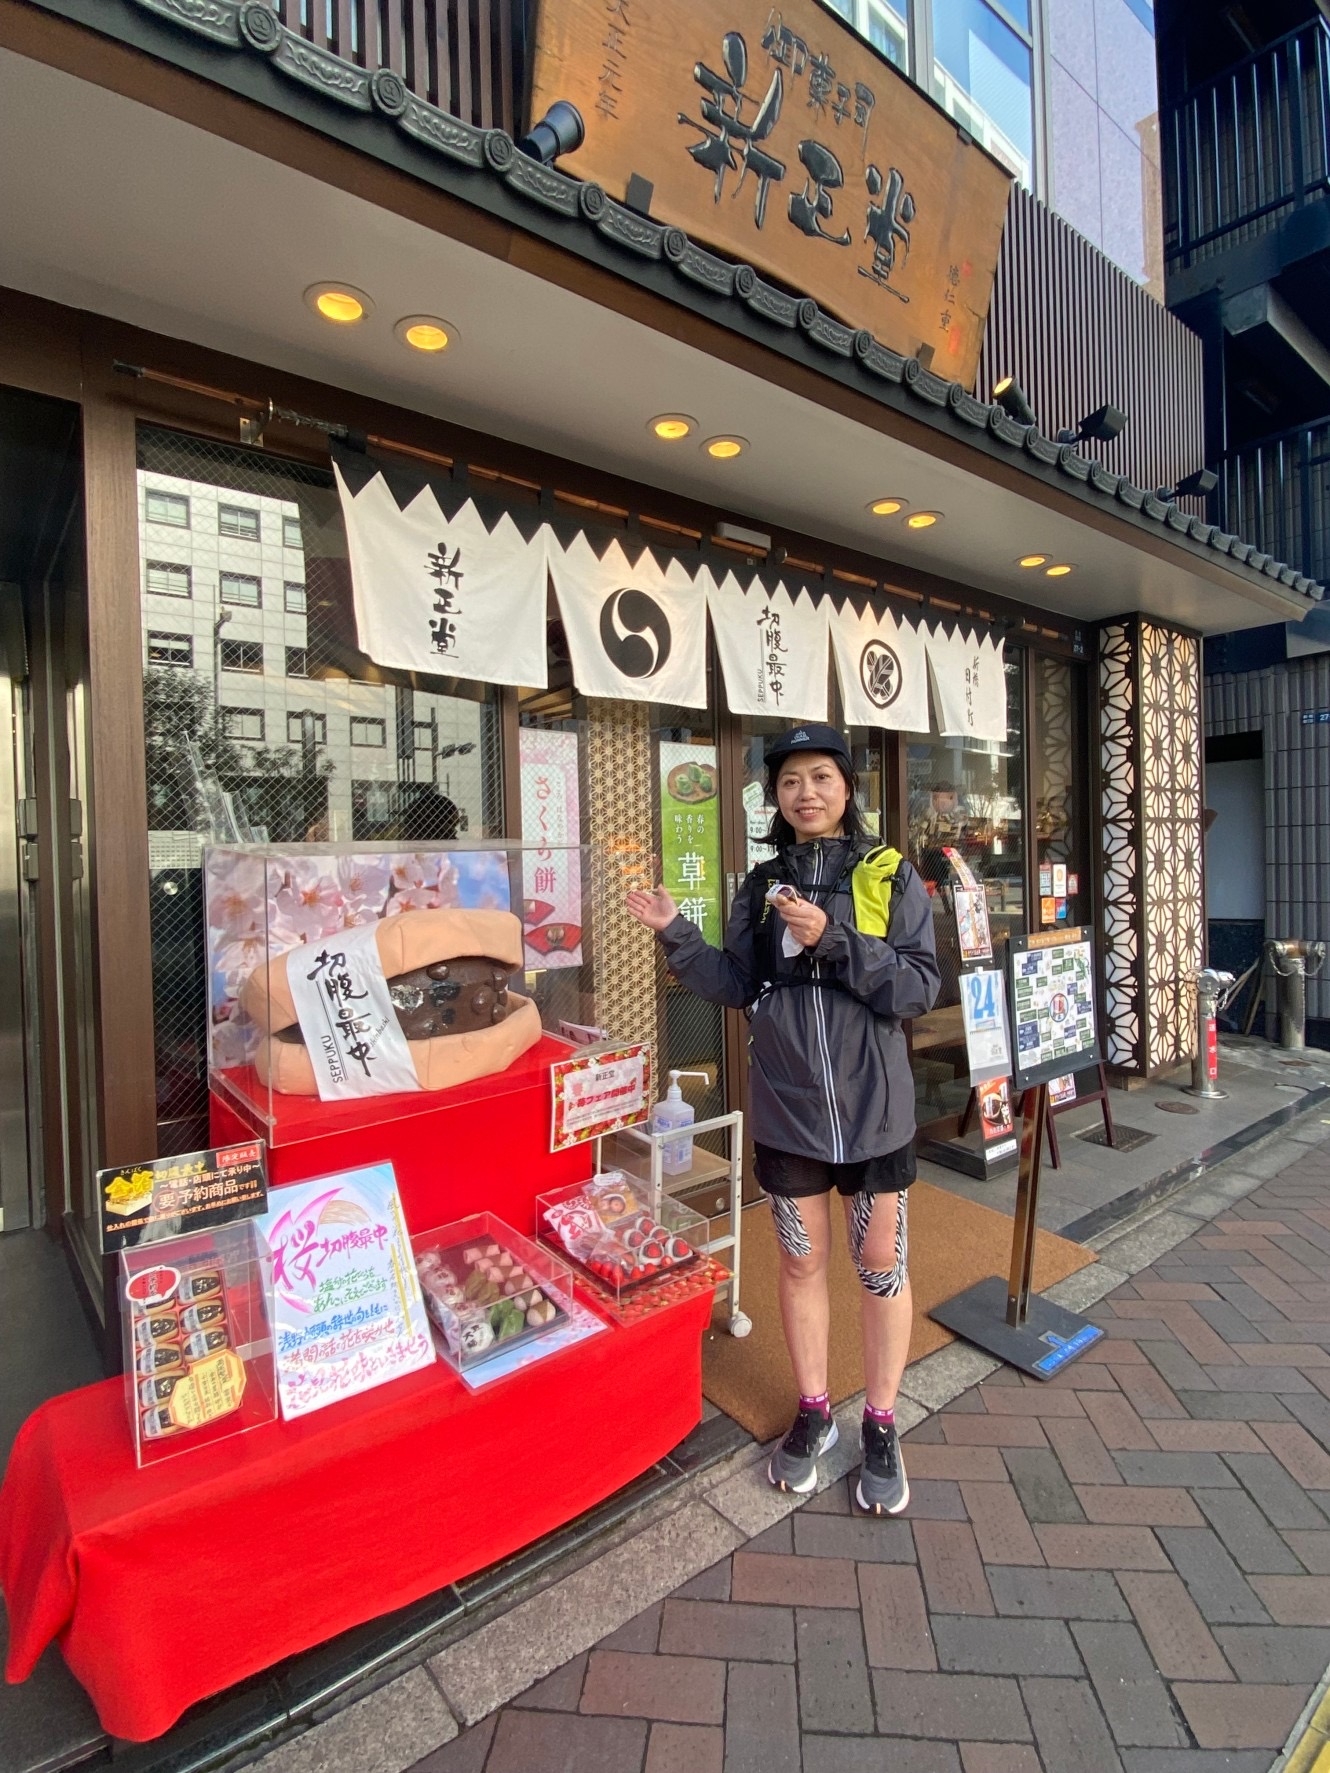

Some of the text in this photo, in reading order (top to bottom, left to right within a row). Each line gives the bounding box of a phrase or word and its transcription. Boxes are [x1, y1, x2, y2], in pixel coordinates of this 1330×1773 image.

[677, 31, 916, 304] 新正堂
[423, 541, 464, 659] 新正堂
[756, 605, 788, 706] 切腹最中
[757, 669, 765, 703] SEPPUKU
[534, 776, 556, 893] さくら餅
[674, 814, 683, 843] 味わう
[686, 814, 694, 844] 香りを
[697, 814, 705, 834] 春の
[677, 852, 707, 932] 草餅
[307, 949, 378, 1078] 切腹最中
[970, 976, 996, 1020] 24
[321, 1035, 343, 1083] SEPPUKU
[595, 1069, 615, 1081] 新正堂
[316, 1223, 389, 1268] 切腹最中
